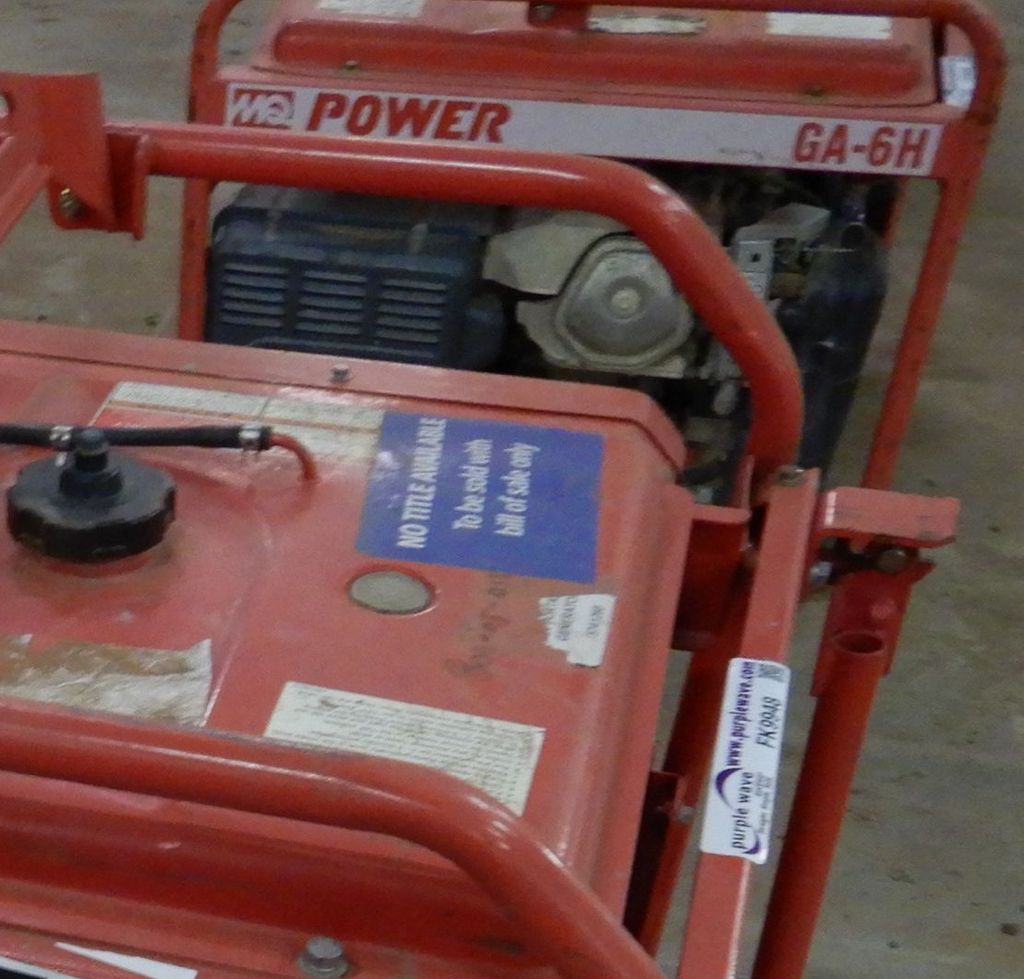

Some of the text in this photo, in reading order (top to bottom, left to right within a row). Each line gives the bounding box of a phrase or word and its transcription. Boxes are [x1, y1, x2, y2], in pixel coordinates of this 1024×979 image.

[306, 92, 512, 143] POWER
[793, 122, 930, 169] GA-6H
[397, 417, 447, 549] NO TITLE AVAILABLE
[454, 495, 485, 512] be
[458, 466, 490, 493] sold
[494, 442, 540, 536] bill of sale only
[452, 514, 483, 529] To
[726, 661, 755, 767] www.purplewave.com
[731, 770, 754, 850] purple wave
